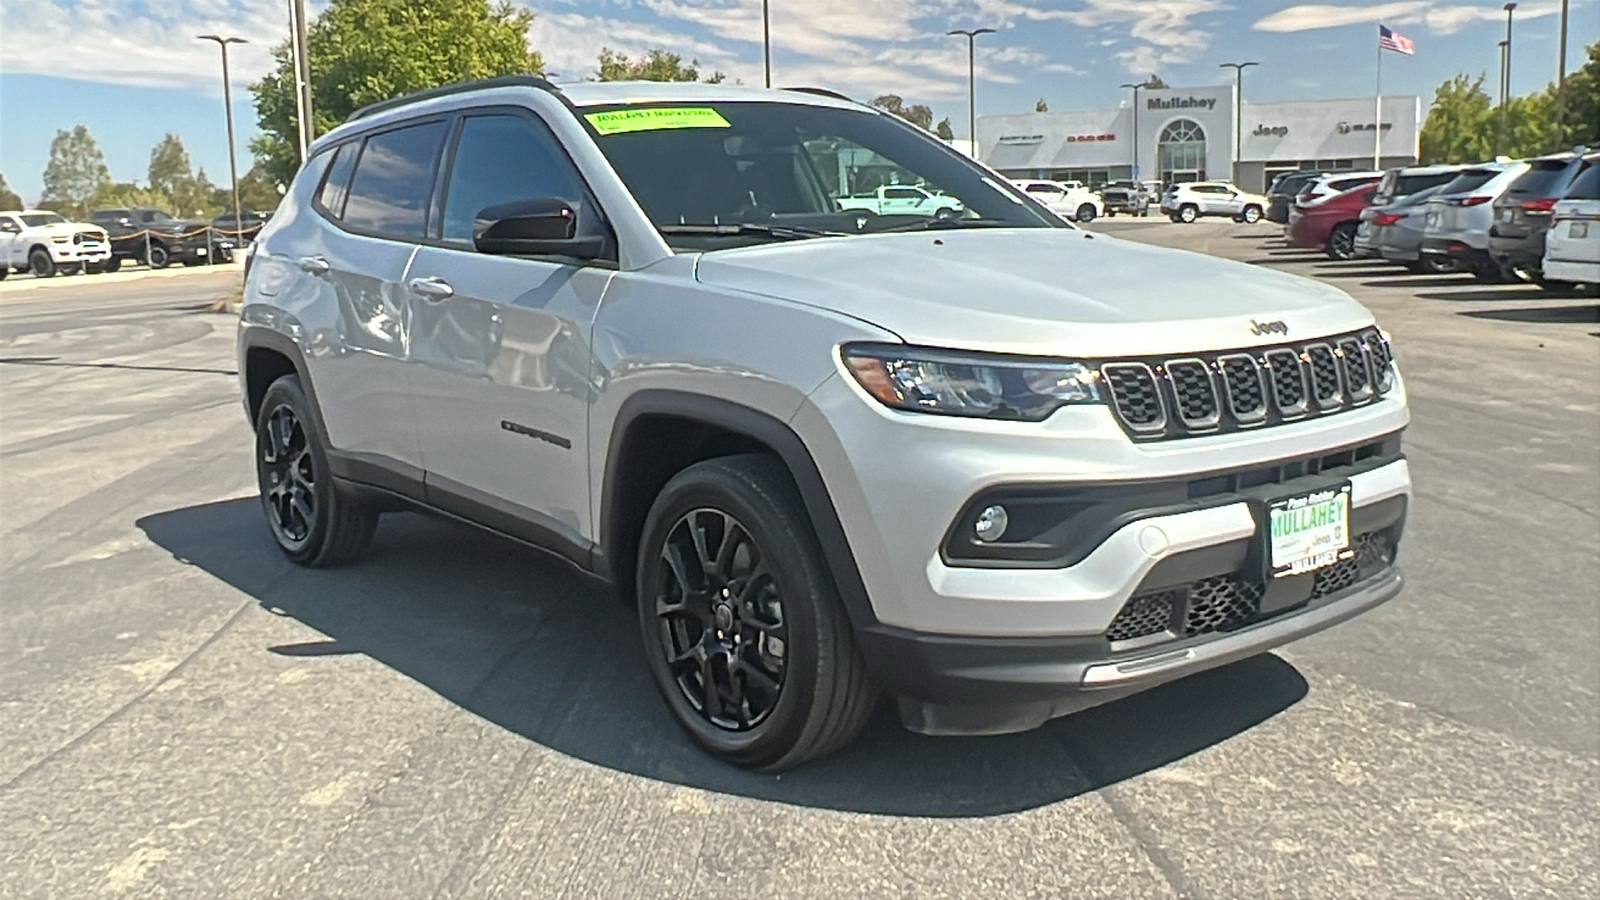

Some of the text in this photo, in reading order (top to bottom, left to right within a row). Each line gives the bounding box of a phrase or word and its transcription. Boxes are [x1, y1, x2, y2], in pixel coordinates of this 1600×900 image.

[1147, 96, 1217, 111] Mullahey
[1252, 123, 1288, 137] Jeep
[1250, 319, 1289, 336] Jeep
[1272, 501, 1344, 537] MULLAHEY
